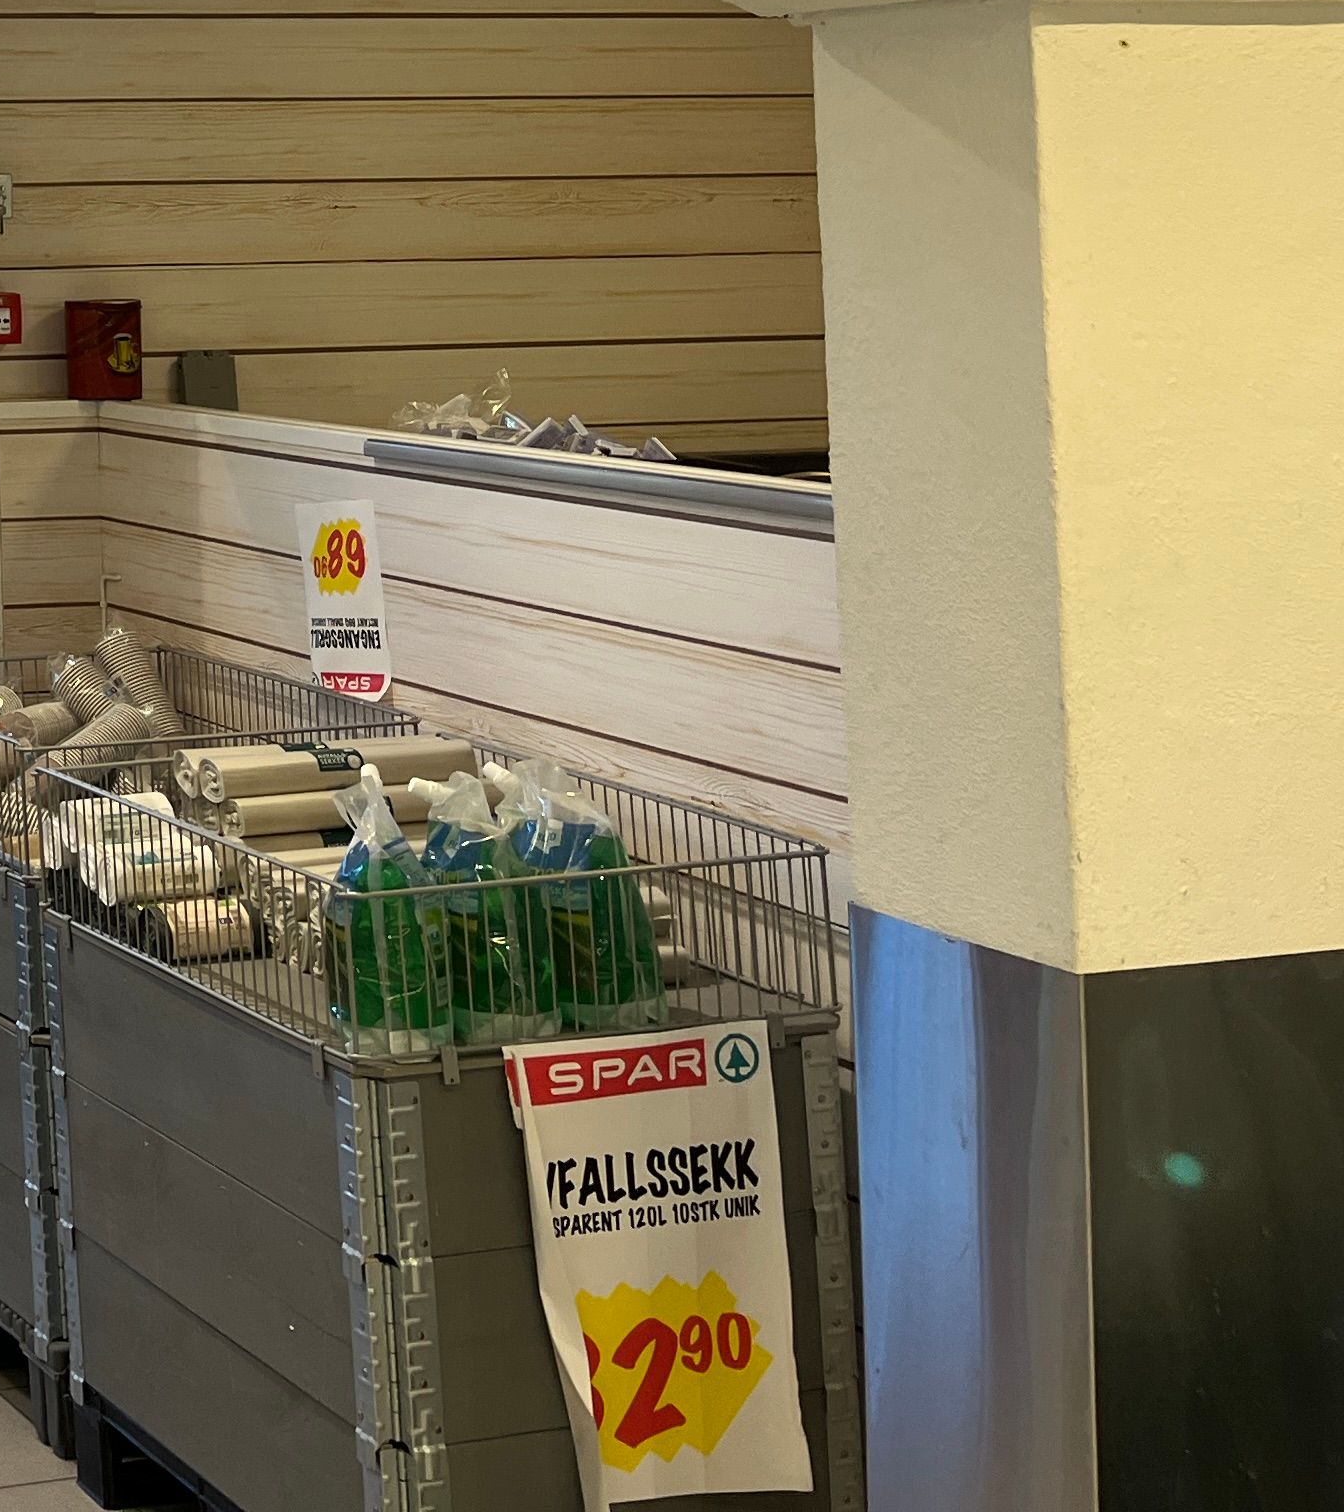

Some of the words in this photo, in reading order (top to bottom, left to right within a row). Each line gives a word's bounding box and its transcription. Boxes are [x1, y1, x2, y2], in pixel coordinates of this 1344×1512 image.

[322, 675, 371, 691] SPAR
[548, 1046, 704, 1096] SPAR
[628, 1205, 668, 1230] 120L
[673, 1198, 721, 1224] 10STK
[724, 1193, 761, 1219] UNIK
